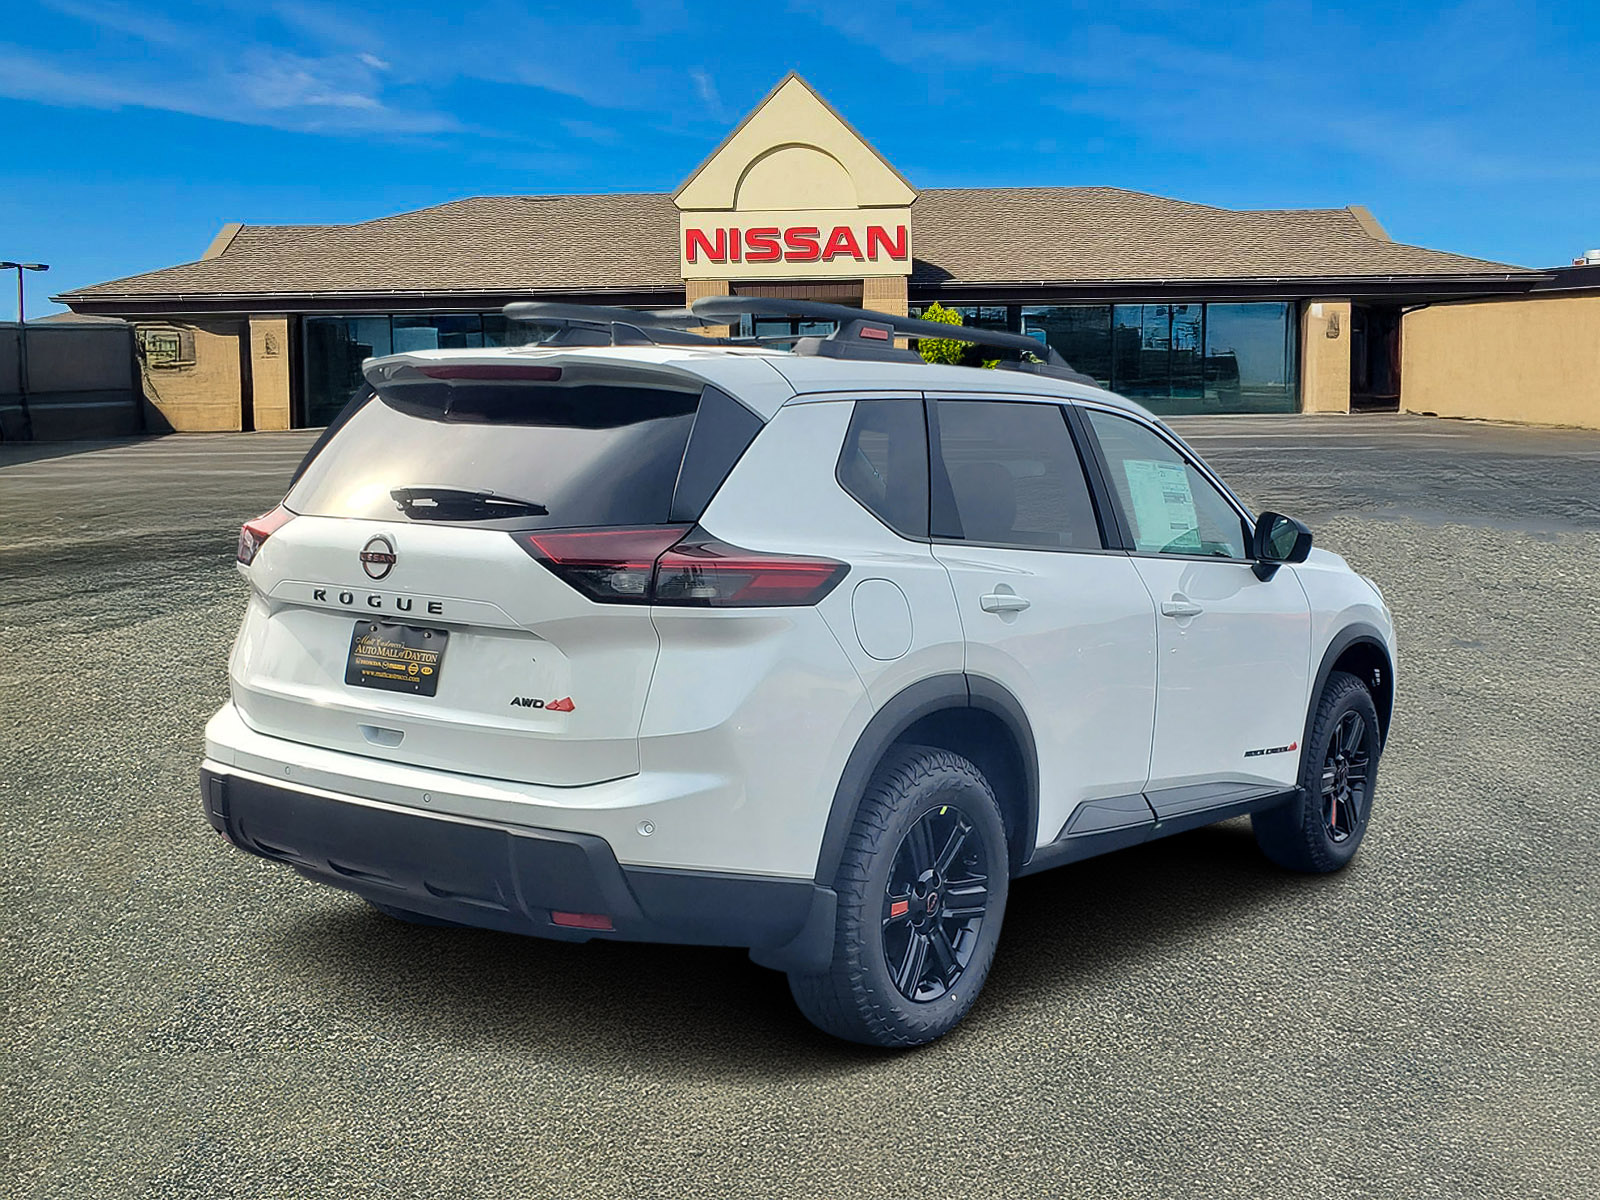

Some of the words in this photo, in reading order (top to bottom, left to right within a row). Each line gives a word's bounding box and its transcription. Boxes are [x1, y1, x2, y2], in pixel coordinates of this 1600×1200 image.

[685, 225, 908, 264] NISSAN
[313, 588, 443, 615] ROGUE
[404, 650, 438, 662] DAYTON
[510, 696, 545, 709] AWD
